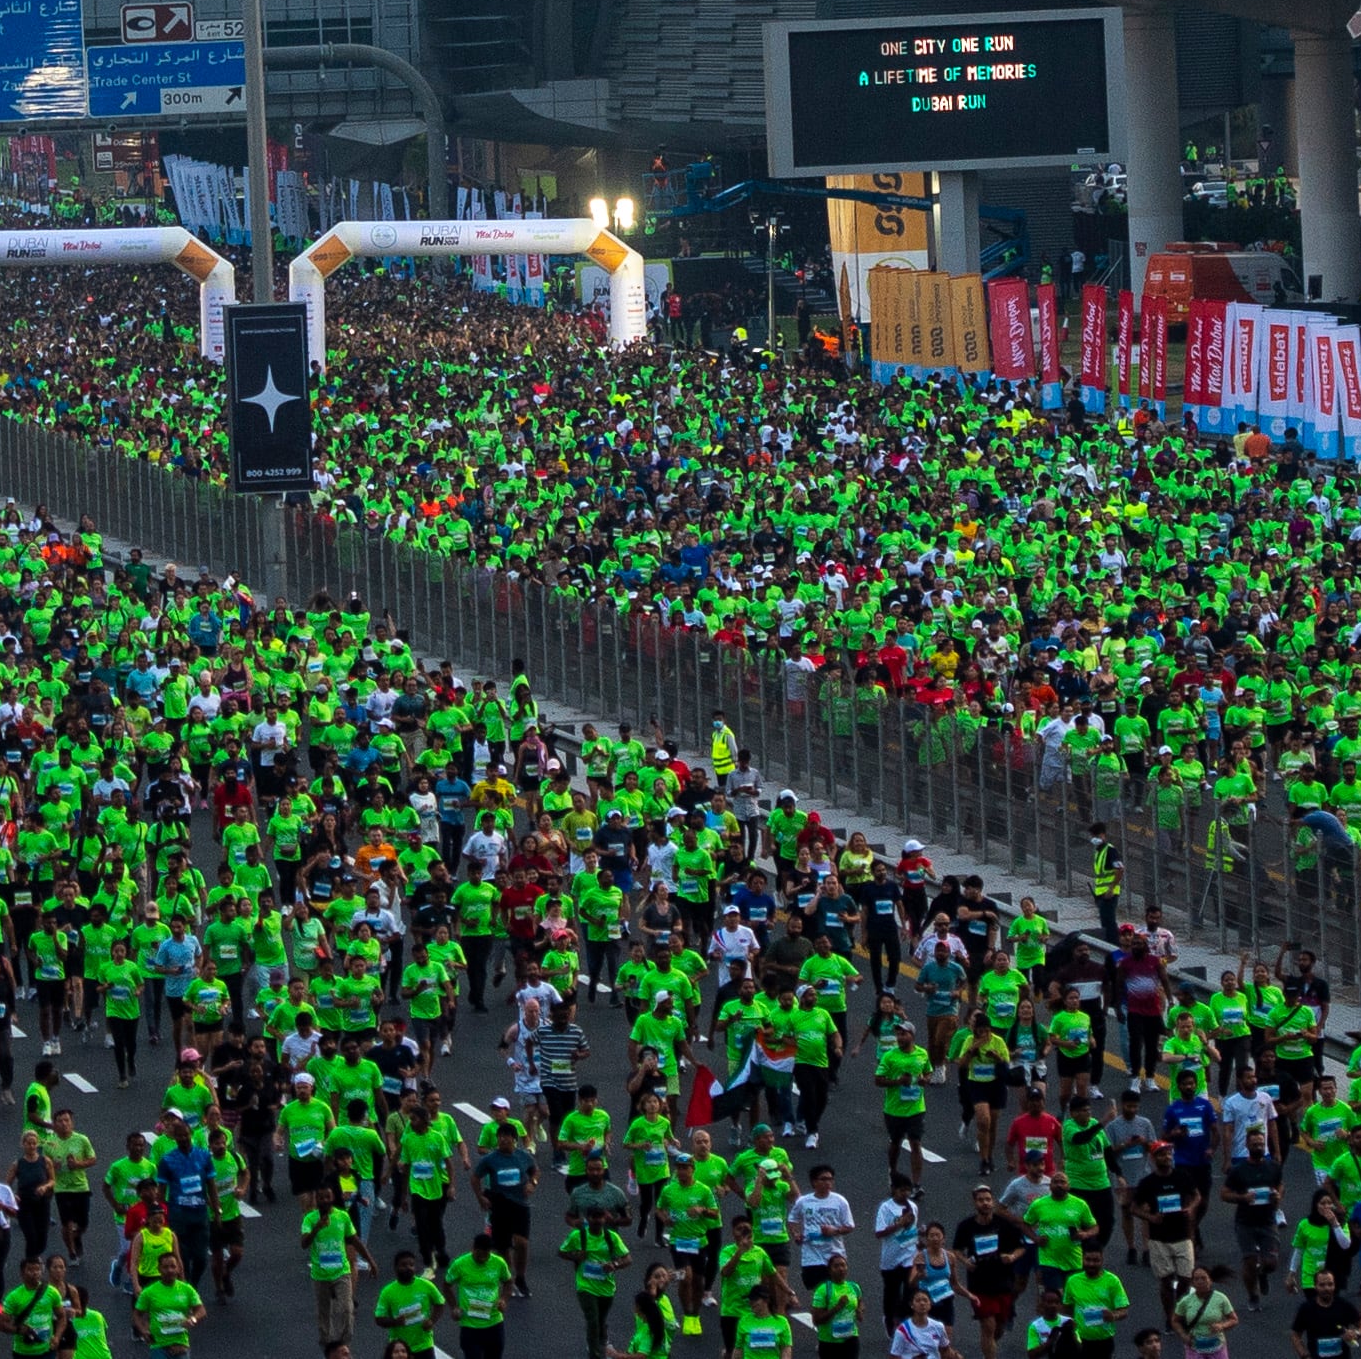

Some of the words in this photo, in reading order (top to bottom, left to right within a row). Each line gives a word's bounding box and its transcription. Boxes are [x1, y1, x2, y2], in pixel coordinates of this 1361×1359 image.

[40, 1, 78, 16] شارع
[224, 22, 244, 36] 52
[881, 41, 908, 55] ONE
[914, 39, 946, 54] CITY
[953, 37, 979, 52] ONE
[984, 36, 1014, 51] RUN
[93, 51, 148, 69] التجاري
[155, 49, 199, 65] المركز
[208, 47, 245, 64] شارع
[94, 75, 127, 87] Trade
[132, 73, 173, 85] Center
[178, 72, 191, 83] St
[859, 71, 869, 86] A
[874, 67, 938, 85] LIFETIME
[944, 67, 961, 81] OF
[967, 64, 1036, 81] MEMORIES
[164, 93, 202, 105] 300m
[912, 96, 953, 112] DUBAI
[958, 94, 986, 110] RUN
[421, 225, 462, 237] DUBAI
[8, 237, 49, 249] DUBAI
[420, 236, 444, 246] RUN
[7, 249, 31, 259] RUN
[1083, 300, 1097, 343] Dubai
[1207, 317, 1223, 367] Dubai
[1274, 332, 1288, 395] talabat
[1208, 365, 1222, 395] Mai
[246, 469, 262, 477] 800
[265, 468, 284, 477] 4252
[285, 467, 302, 476] 999
